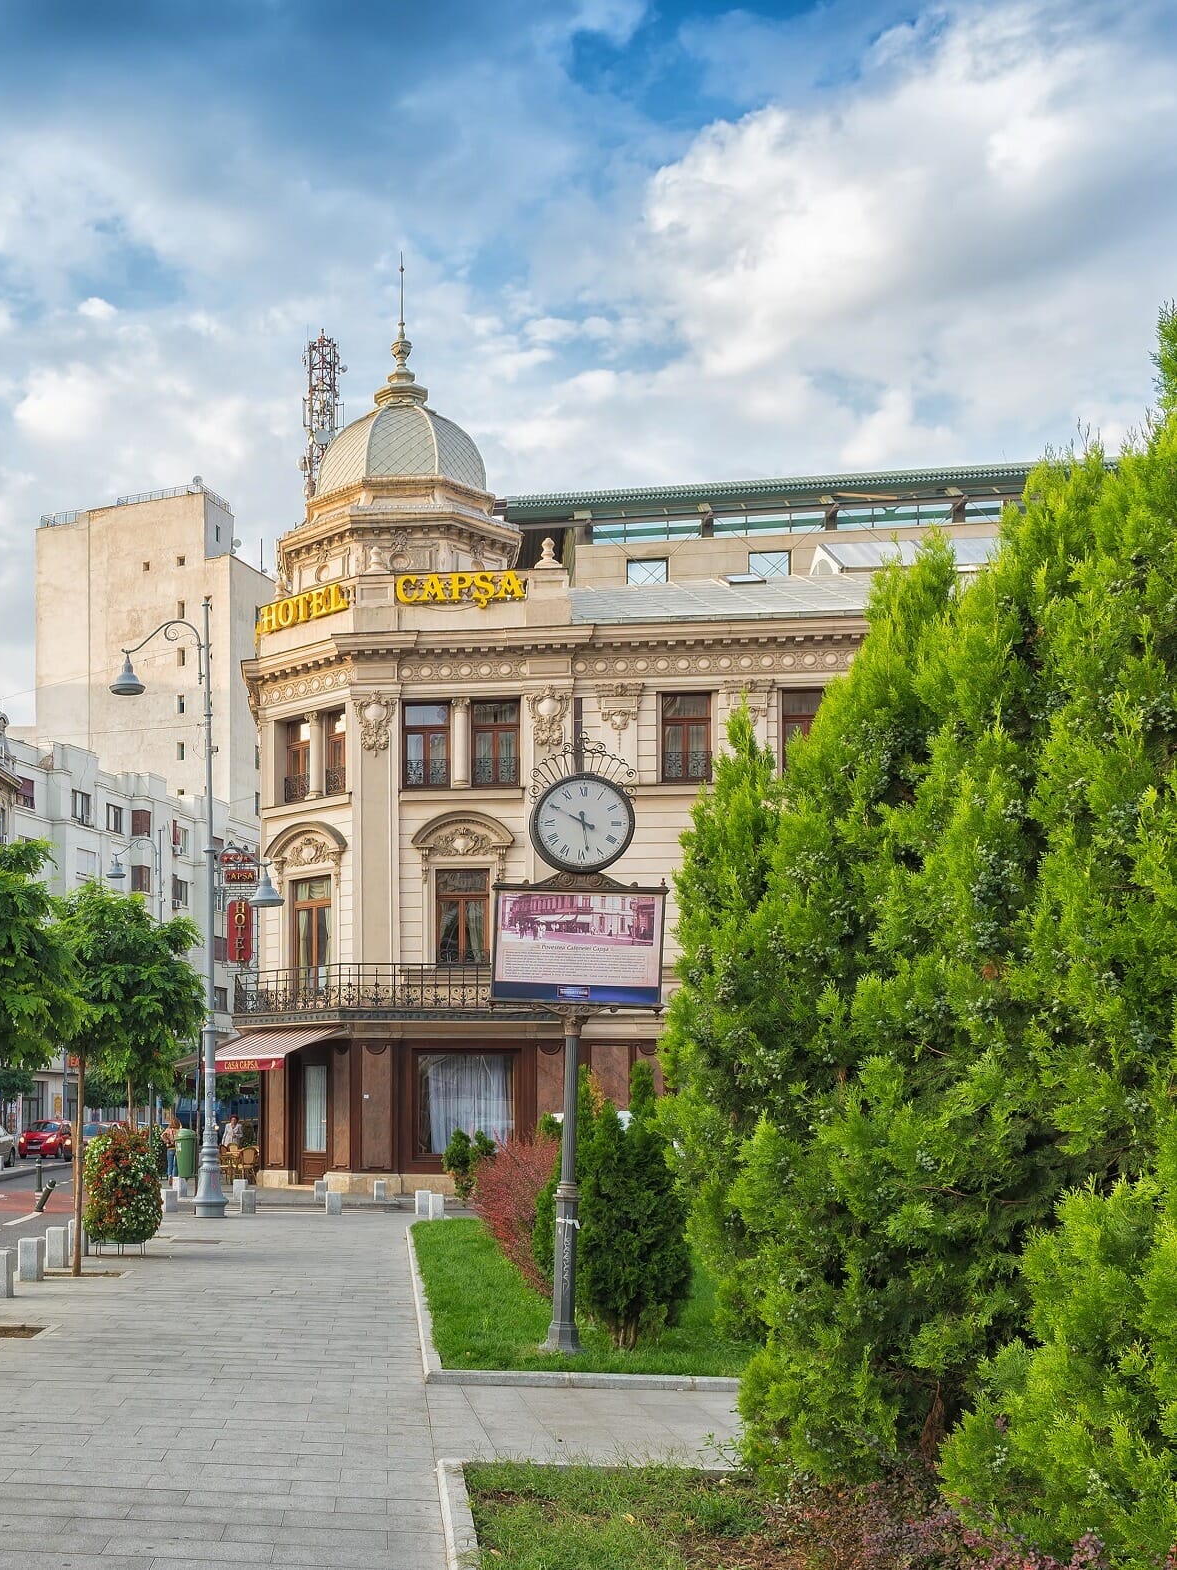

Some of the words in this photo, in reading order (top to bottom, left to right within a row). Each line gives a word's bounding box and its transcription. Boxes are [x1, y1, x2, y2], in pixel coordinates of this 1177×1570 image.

[261, 584, 349, 633] HOTEL
[234, 901, 246, 961] HOTEL
[224, 1061, 239, 1070] CASA
